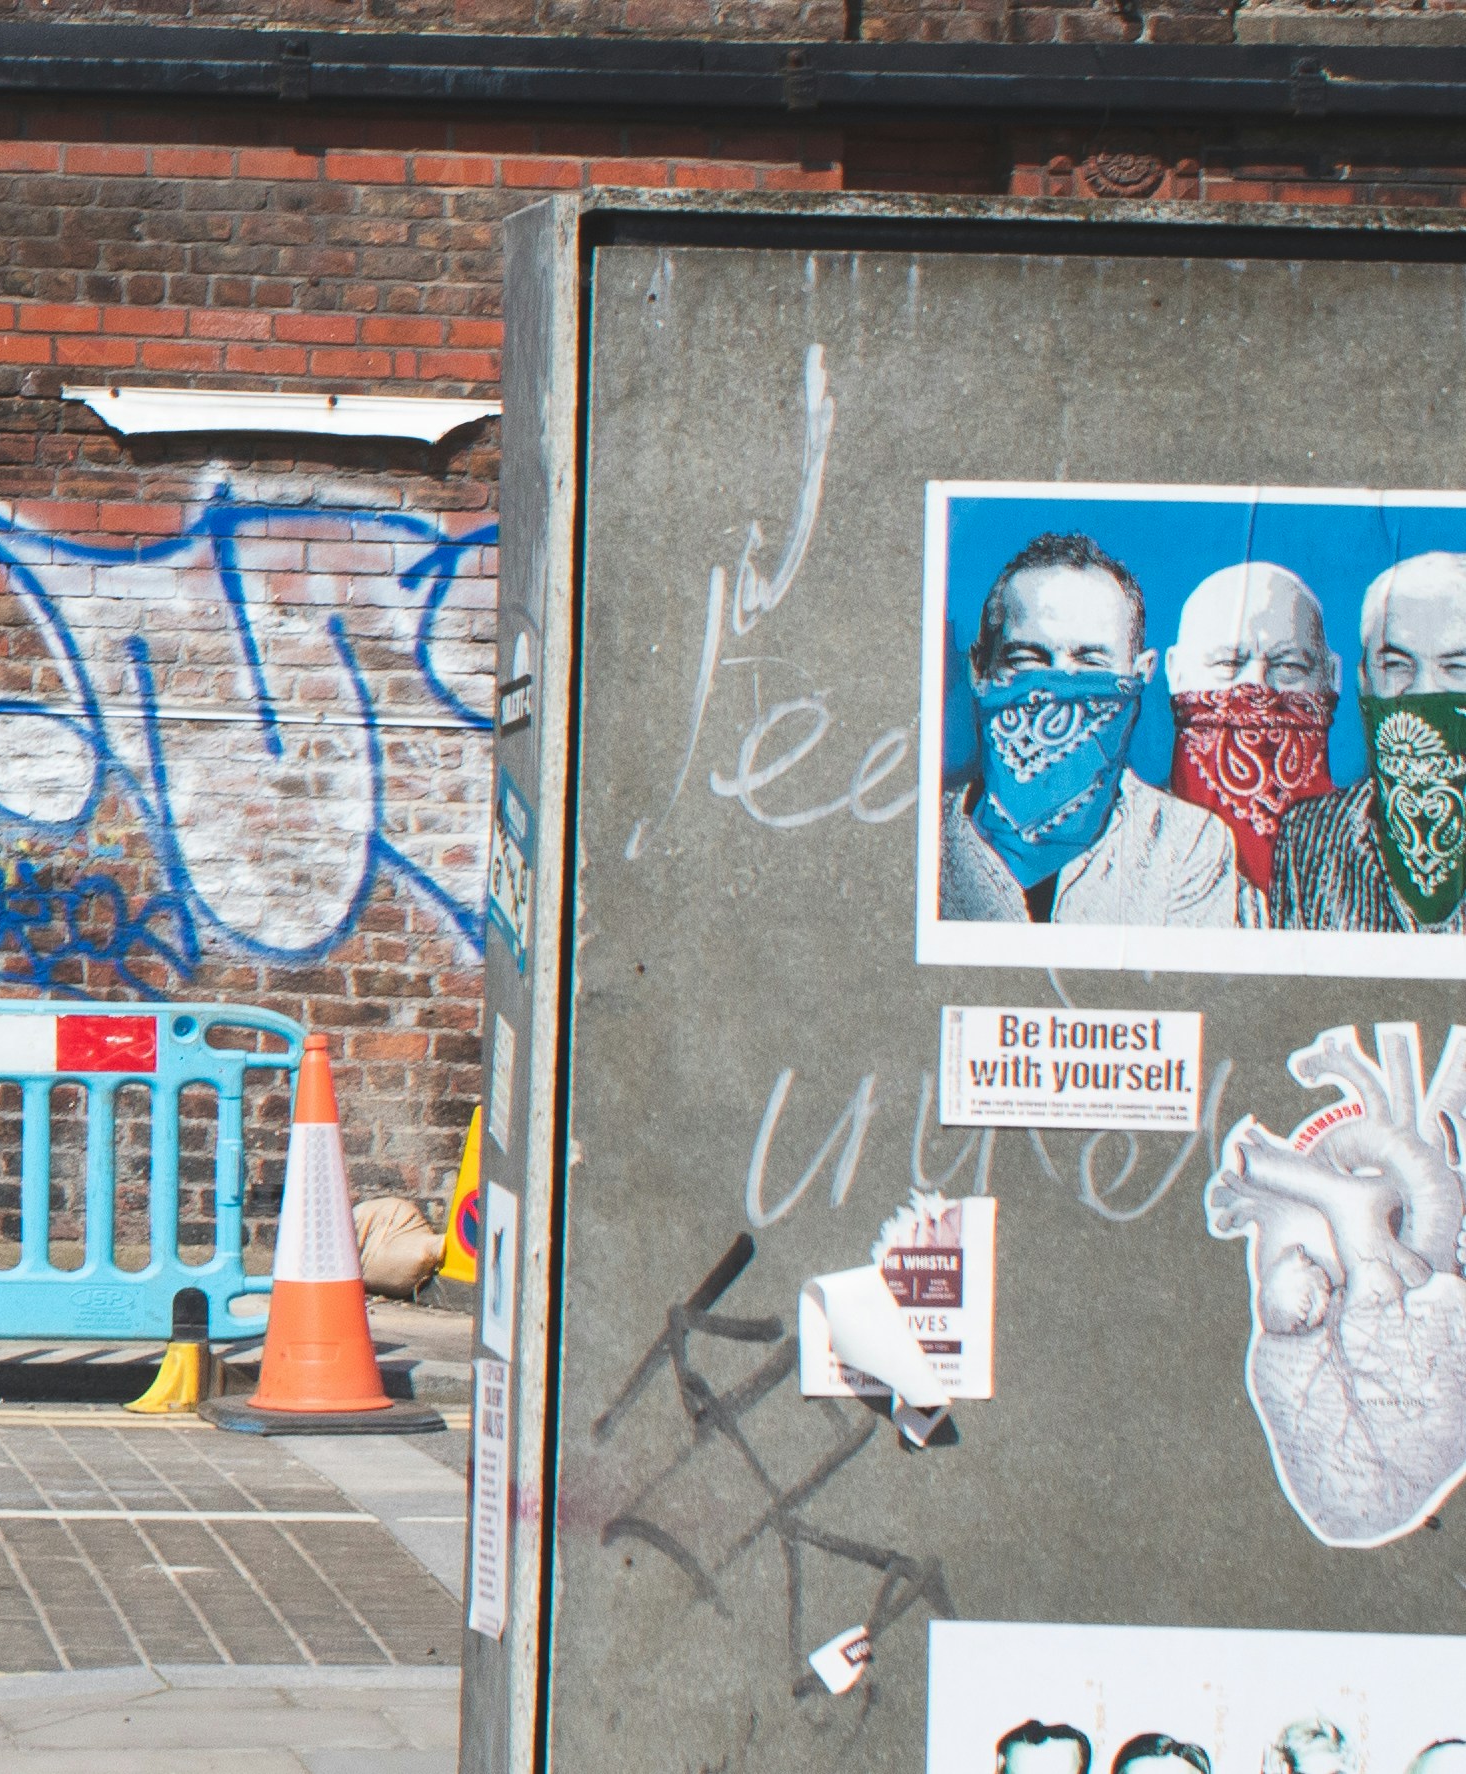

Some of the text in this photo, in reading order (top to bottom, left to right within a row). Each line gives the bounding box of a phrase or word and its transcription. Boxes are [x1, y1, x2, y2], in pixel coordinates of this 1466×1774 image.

[998, 1014, 1162, 1051] Be honest
[969, 1053, 1192, 1094] with yourself.
[903, 1254, 958, 1271] WHISTLE
[908, 1315, 948, 1332] IVES
